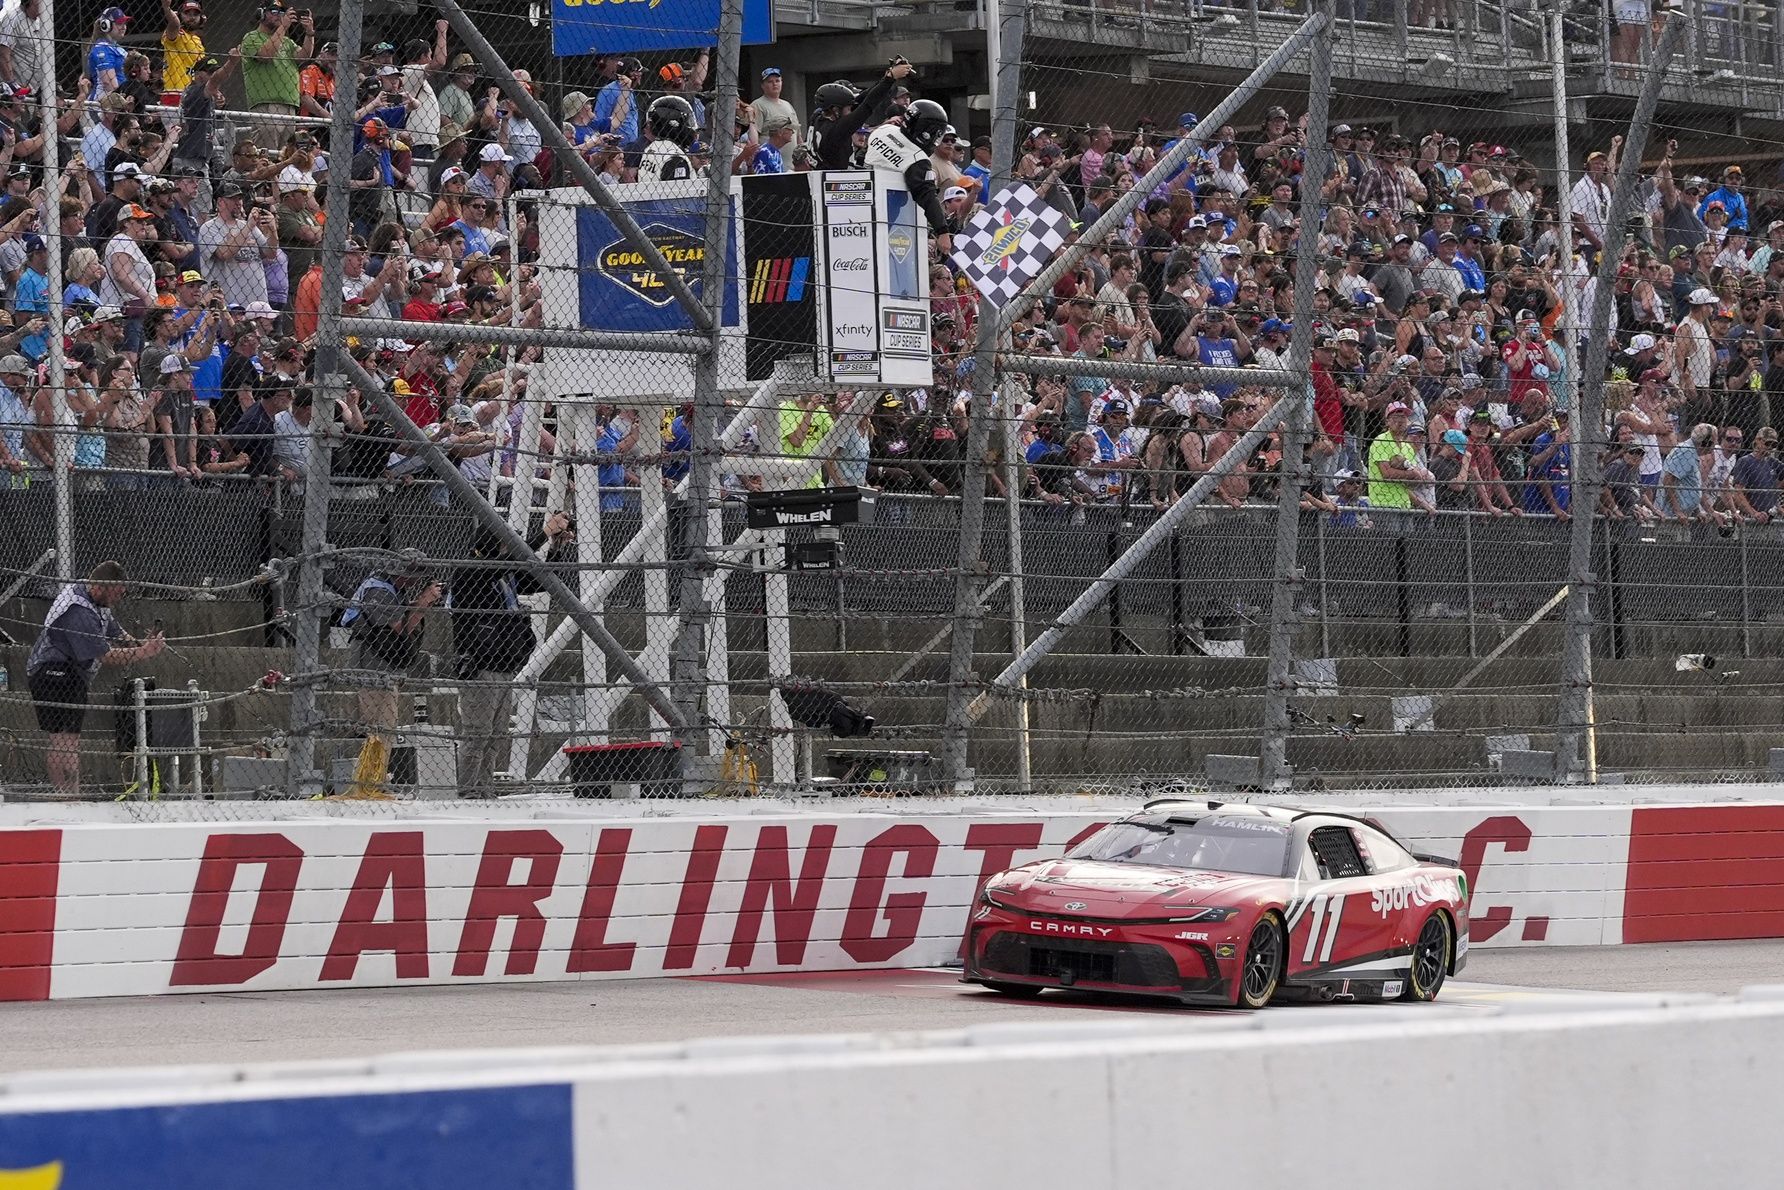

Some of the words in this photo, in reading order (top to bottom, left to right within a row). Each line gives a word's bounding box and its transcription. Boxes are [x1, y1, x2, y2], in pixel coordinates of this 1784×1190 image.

[870, 137, 904, 168] OFFICIAL
[839, 183, 866, 191] NASCAR
[831, 193, 844, 201] CUP
[845, 193, 867, 201] SERIES
[832, 226, 867, 238] BUSCH
[606, 247, 704, 266] GOOYEAR
[896, 313, 921, 329] NASCAR
[835, 323, 873, 338] xfinity
[889, 334, 901, 347] CUP
[902, 334, 922, 349] SERIES
[846, 353, 873, 361] NASCAR
[837, 363, 850, 371] CUP
[851, 363, 873, 371] SERIES
[775, 508, 832, 524] WHELEN
[802, 561, 830, 569] WHELEN
[1211, 819, 1284, 835] HAMLIN
[168, 822, 1110, 987] DARLINGT
[1030, 921, 1113, 937] CAMRY
[1302, 893, 1346, 963] 11
[1175, 931, 1209, 941] JGR
